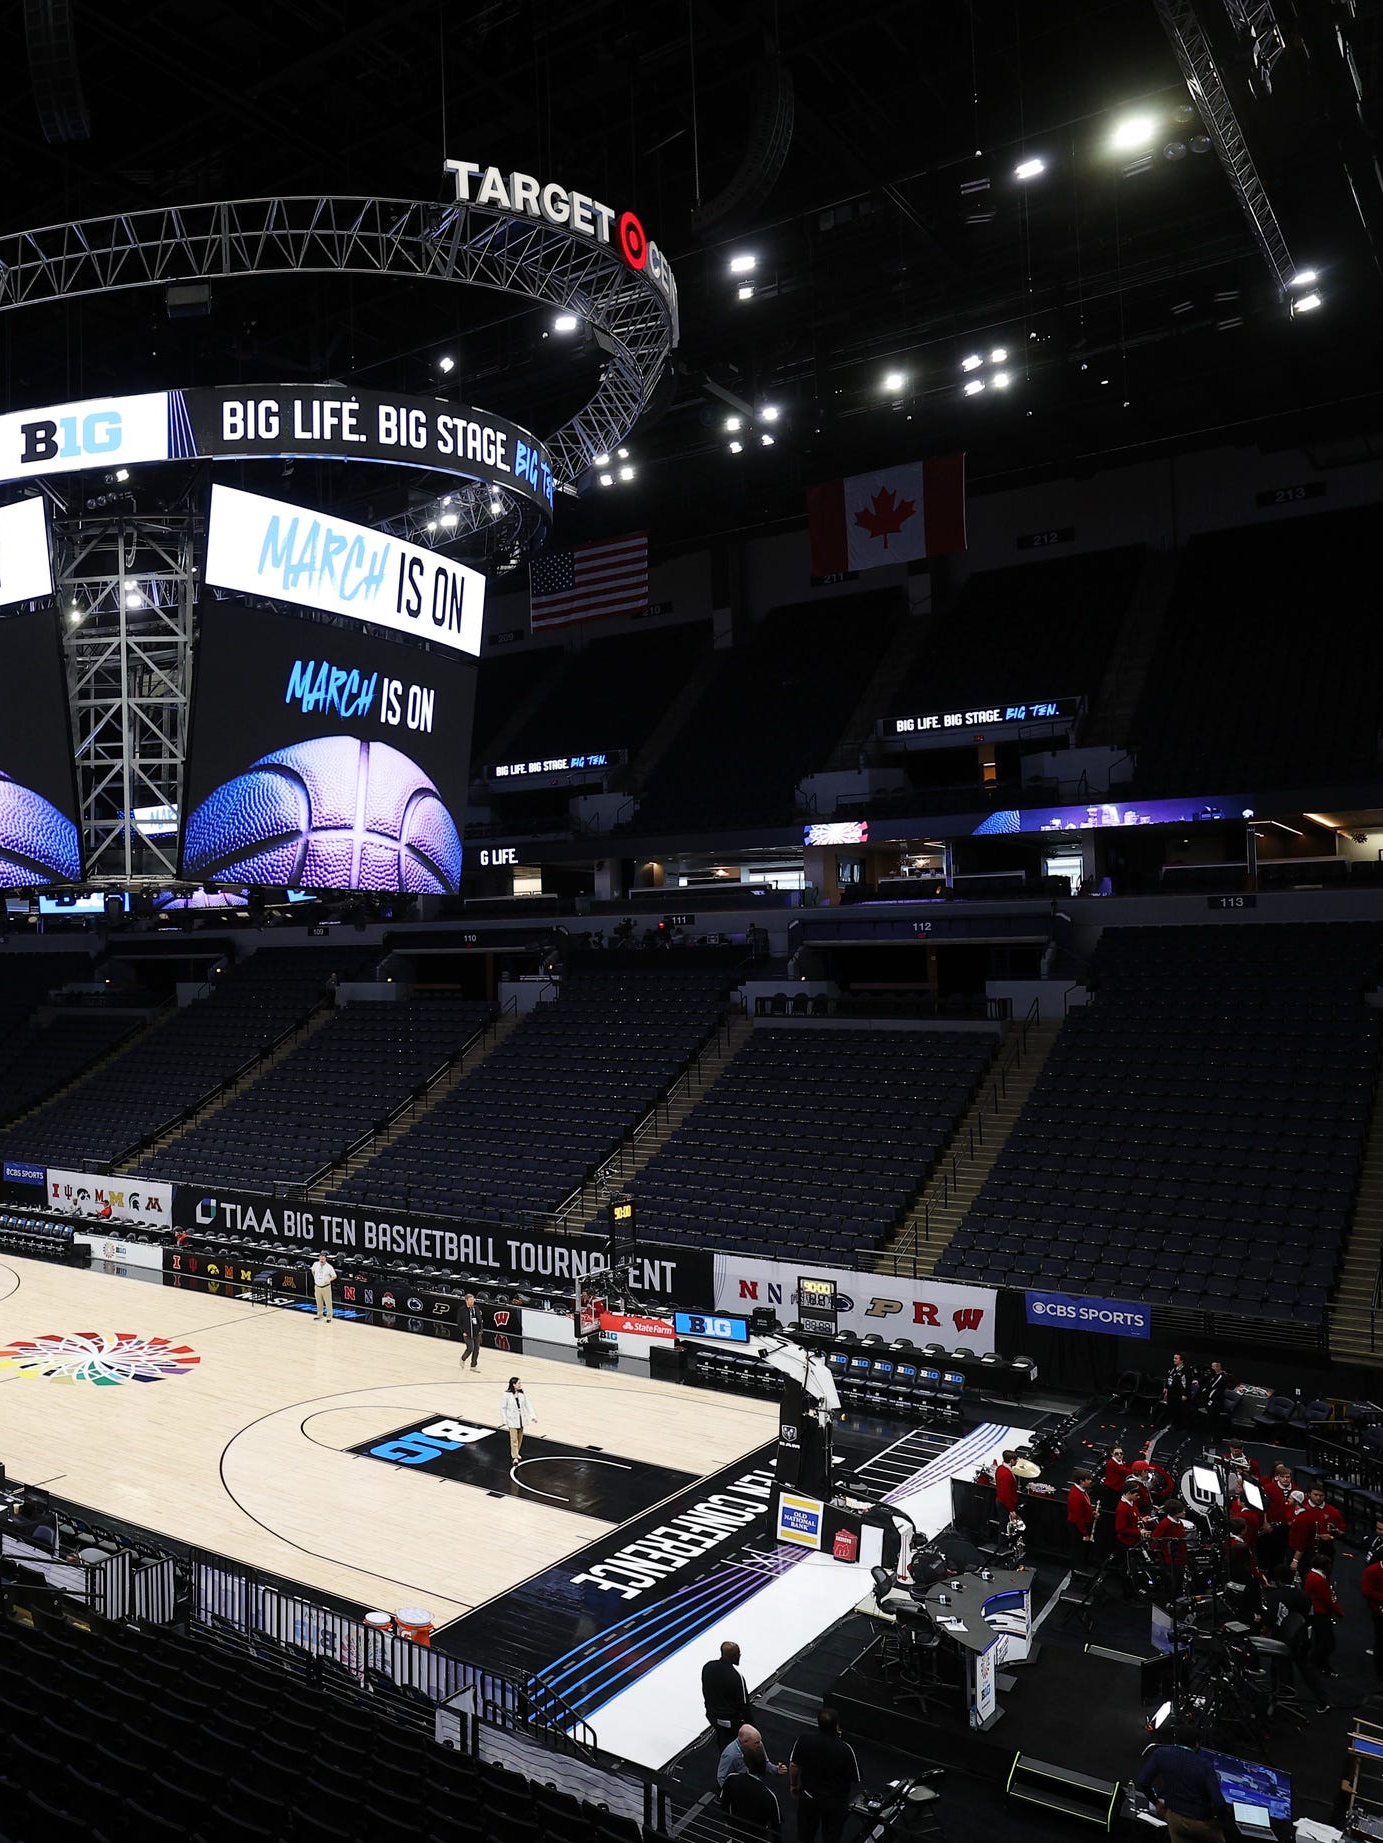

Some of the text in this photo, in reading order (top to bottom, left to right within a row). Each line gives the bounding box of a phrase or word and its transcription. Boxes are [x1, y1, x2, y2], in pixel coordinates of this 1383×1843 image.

[444, 159, 616, 244] TARGET
[222, 401, 280, 441] BIG
[293, 400, 367, 443] LIFE.
[378, 406, 428, 450] BIG
[436, 421, 511, 473] STAGE.
[514, 440, 538, 492] BIG
[1275, 488, 1305, 500] 213
[1034, 533, 1058, 545] 212
[258, 515, 465, 633] MARCH IS ON
[285, 660, 435, 733] MARCH IS ON
[896, 703, 1060, 732] BIG LIFE. BIG STAGE. BIG TEN.
[496, 766, 508, 777] BIG
[529, 762, 542, 773] BIG
[571, 756, 584, 768] BIG
[492, 848, 519, 865] LIFE.
[1220, 897, 1244, 908] 113
[671, 916, 687, 925] 111
[912, 922, 931, 931] 112
[464, 934, 476, 942] 110
[11, 1168, 44, 1180] CBS SPORTS
[221, 1203, 278, 1235] TIAA
[283, 1210, 314, 1240] BIG
[320, 1215, 356, 1246] TEN
[365, 1221, 500, 1268] BASKETBALL
[804, 1281, 831, 1295] 90:00
[1046, 1303, 1144, 1327] CBS SPORTS
[779, 1441, 800, 1449] RAM
[784, 1514, 816, 1527] NATIONAL
[793, 1511, 808, 1519] OLD
[790, 1522, 808, 1531] BANK
[570, 1494, 768, 1600] CONFERENCE
